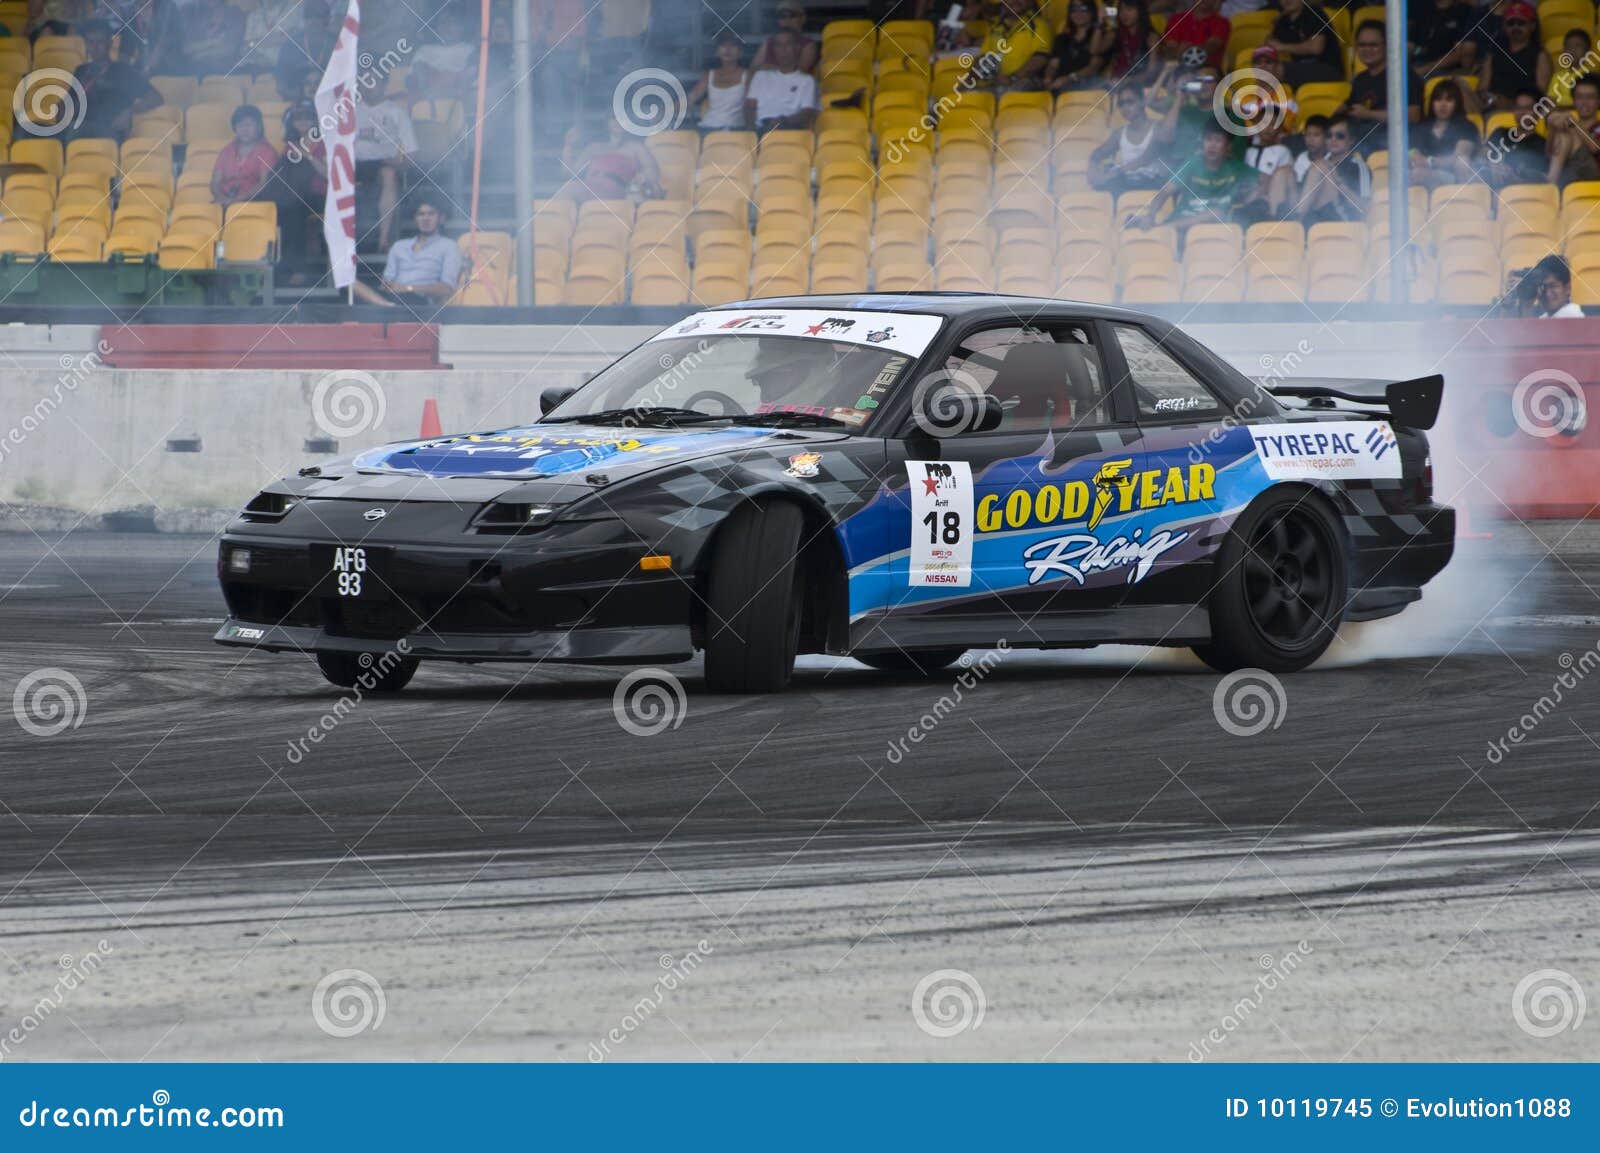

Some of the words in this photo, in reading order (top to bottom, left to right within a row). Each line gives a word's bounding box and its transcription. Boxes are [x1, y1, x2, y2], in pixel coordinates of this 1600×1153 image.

[866, 355, 909, 395] TEIN
[1255, 431, 1360, 458] TYREPAC
[925, 463, 952, 477] PRO
[1272, 456, 1357, 470] www.tyrepac.com
[923, 511, 960, 545] 18
[333, 547, 366, 572] AFG
[1024, 528, 1189, 586] Racing
[338, 572, 362, 597] 93
[925, 574, 958, 583] NISSAN
[236, 627, 265, 639] TEIN
